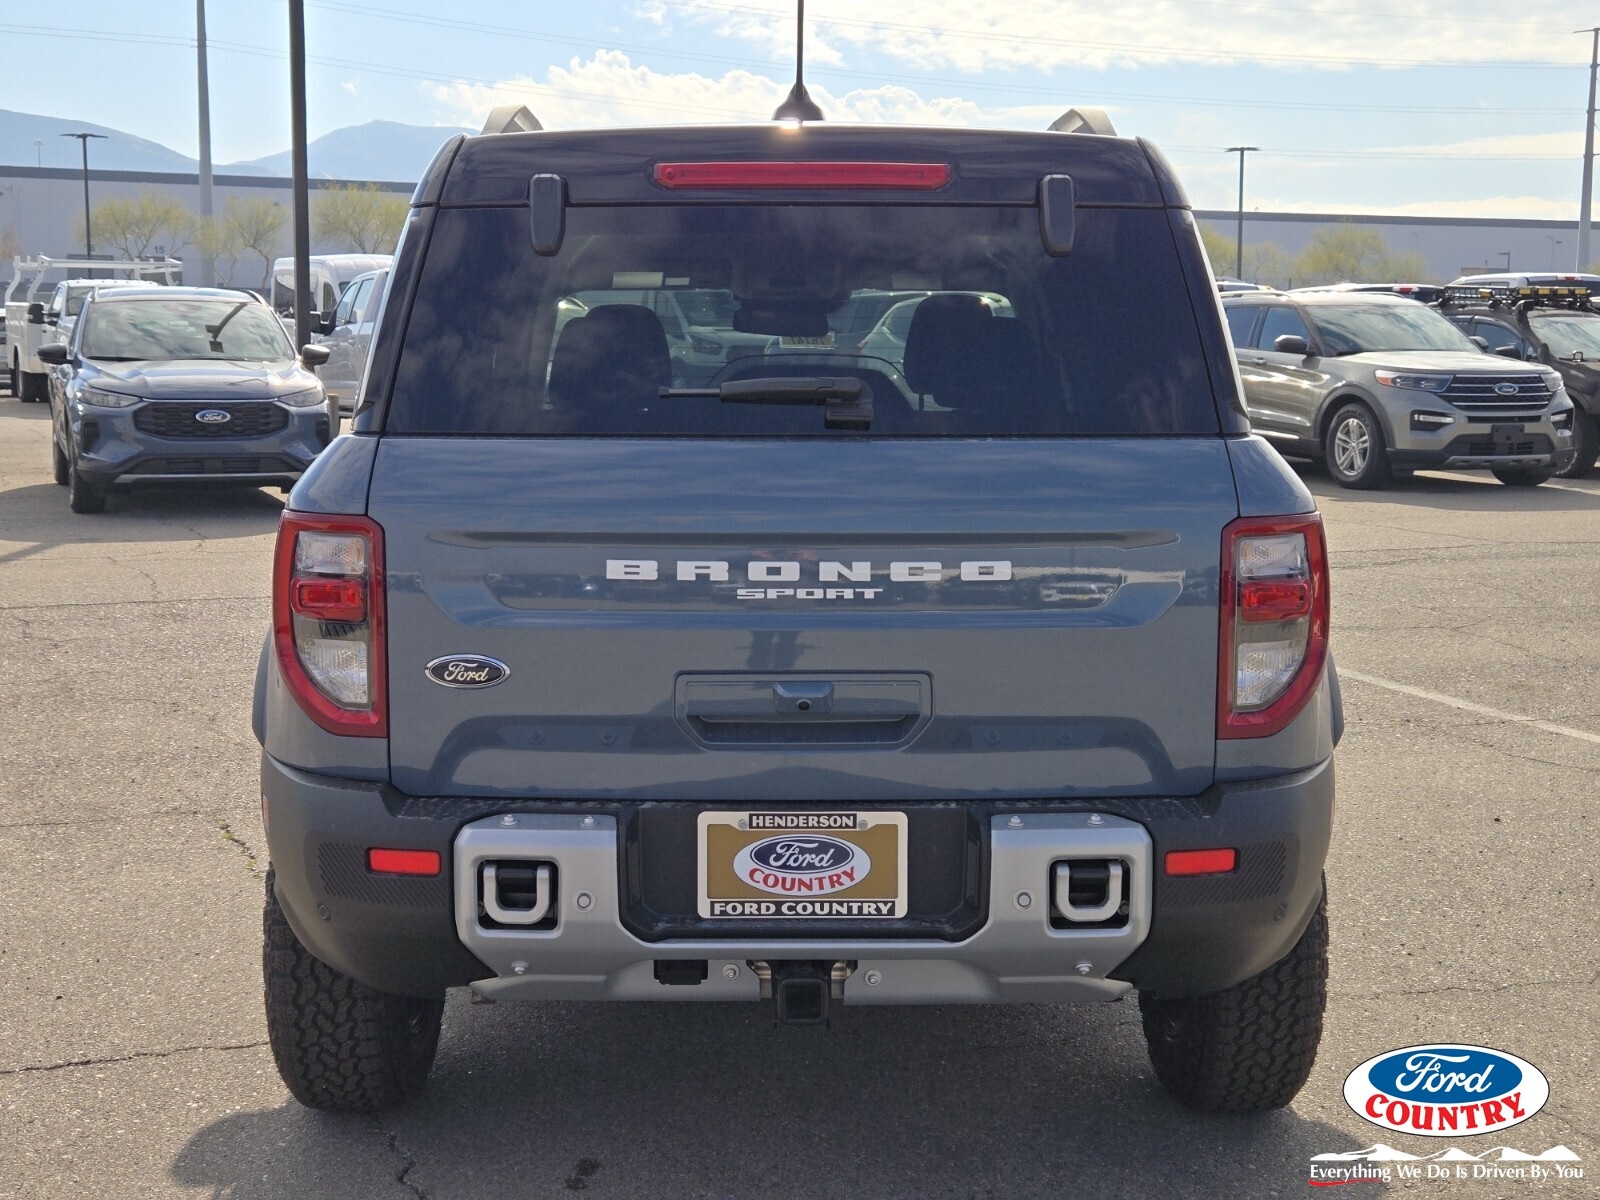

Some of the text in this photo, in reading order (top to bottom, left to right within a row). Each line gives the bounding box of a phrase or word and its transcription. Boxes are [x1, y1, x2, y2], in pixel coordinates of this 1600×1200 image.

[154, 246, 165, 254] 15
[606, 559, 1012, 582] BRONCO
[736, 588, 883, 599] SPORT
[443, 661, 490, 681] Ford
[752, 815, 854, 828] HENDERSON
[769, 841, 835, 868] Ford
[748, 866, 856, 892] COUNTRY
[713, 902, 893, 915] FORD COUNTRY
